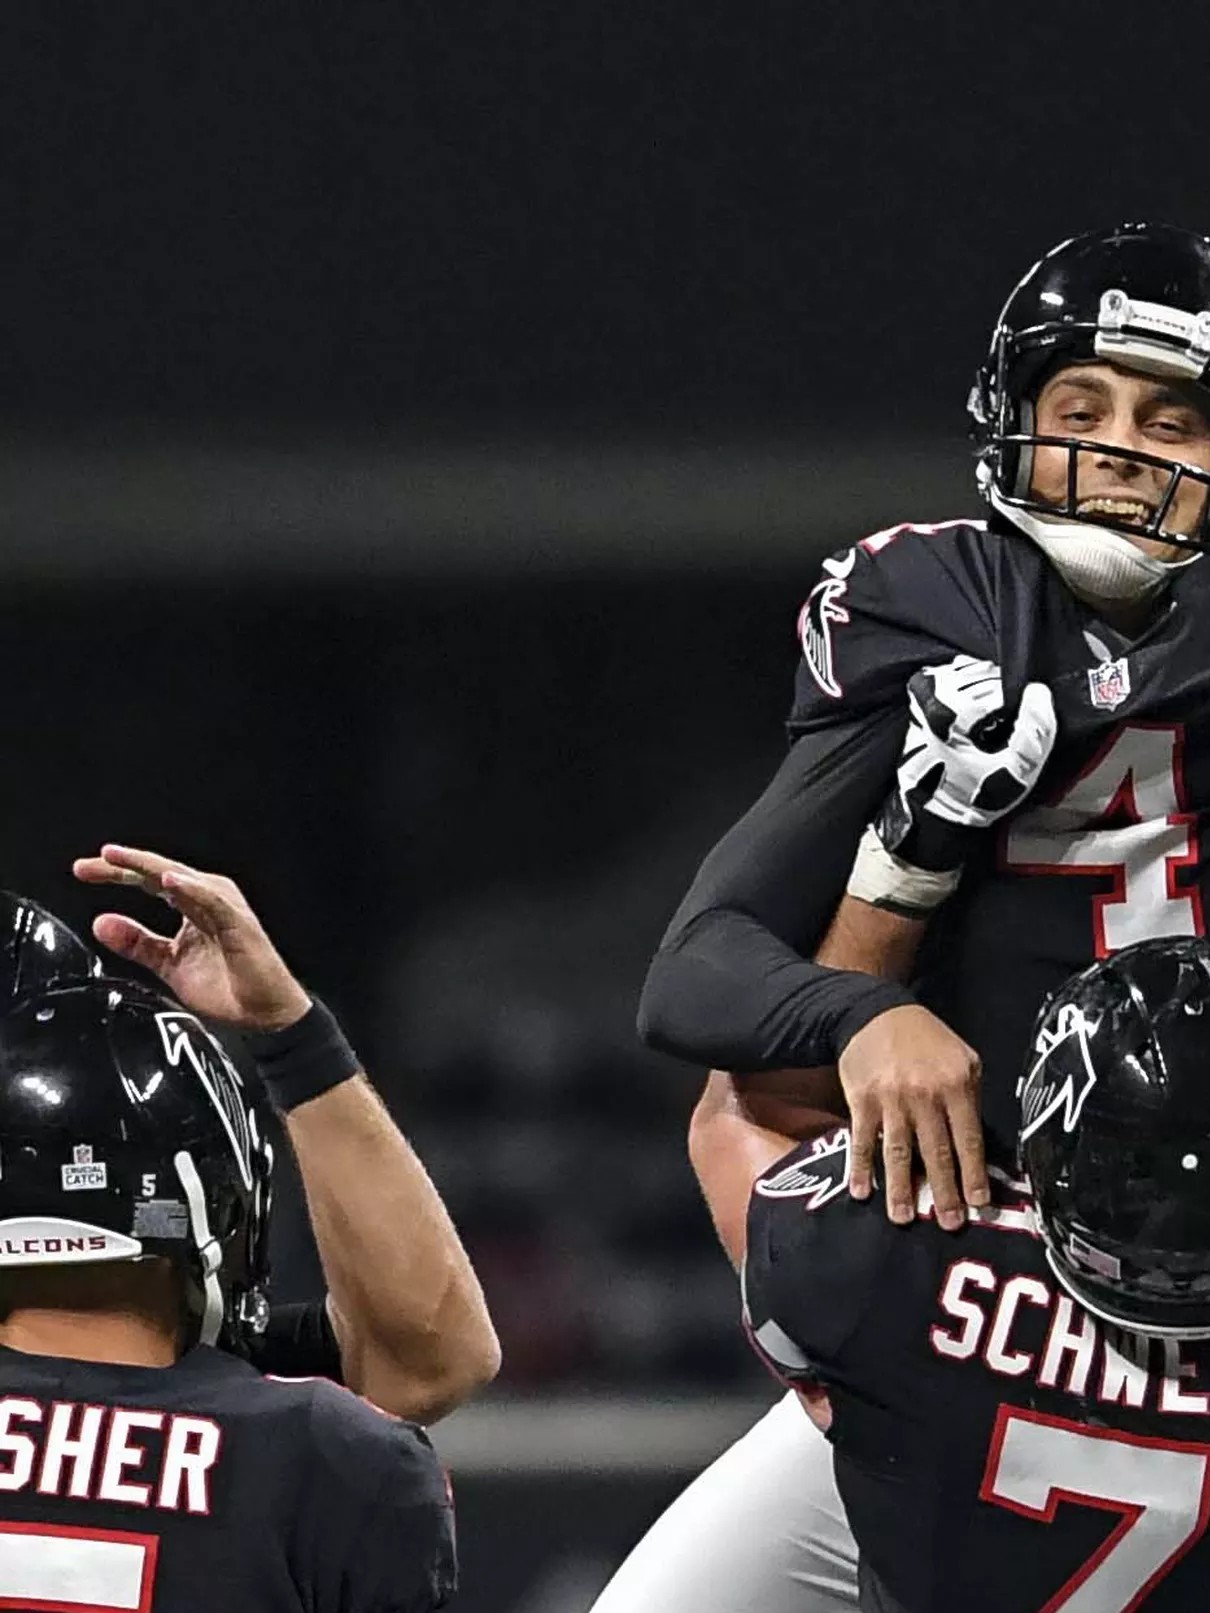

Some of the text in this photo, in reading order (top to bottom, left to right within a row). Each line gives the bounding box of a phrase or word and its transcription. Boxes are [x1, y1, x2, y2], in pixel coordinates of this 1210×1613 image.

[1004, 725, 1206, 959] 4
[65, 1174, 104, 1186] CATCH
[142, 1173, 156, 1196] 5
[0, 1235, 106, 1254] LCONS
[0, 1395, 221, 1515] SHER
